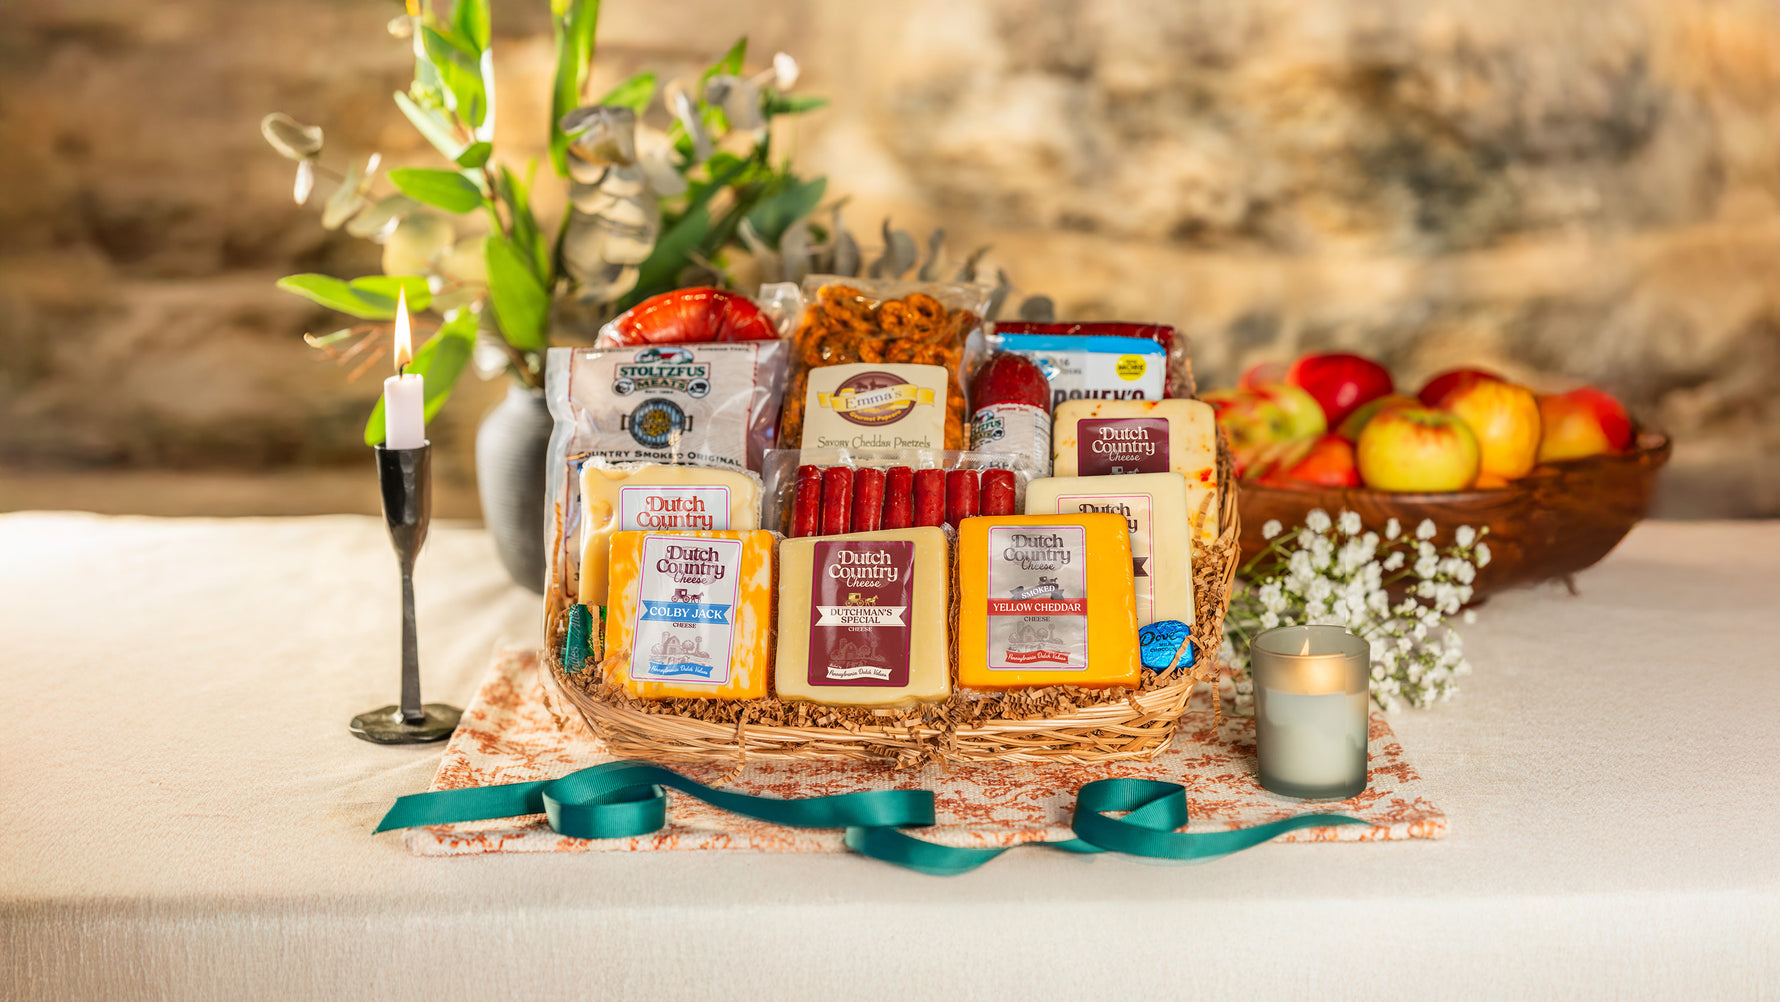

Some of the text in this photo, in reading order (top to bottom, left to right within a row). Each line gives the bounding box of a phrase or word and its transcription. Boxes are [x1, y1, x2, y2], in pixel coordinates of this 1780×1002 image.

[620, 366, 706, 377] STOLTZFUS
[637, 379, 686, 389] MEATS
[845, 388, 903, 409] Emma's
[1099, 427, 1148, 440] Dutch
[817, 434, 931, 449] Savory Cheddar Pretzels
[1092, 440, 1155, 456] Country
[688, 451, 742, 467] ORIGINAL
[1109, 451, 1141, 462] Cheese
[646, 496, 705, 512] Dutch
[1079, 503, 1131, 517] Dutch
[637, 511, 713, 531] Country
[1012, 534, 1064, 548] Dutch
[666, 545, 719, 562] Dutch
[838, 550, 891, 565] Dutch
[1003, 547, 1072, 565] Country
[656, 559, 726, 580] Country
[1021, 557, 1055, 570] Cheese
[674, 572, 708, 584] Cheese
[828, 563, 898, 582] Country
[846, 576, 881, 588] Cheese
[1021, 585, 1055, 600] SMOKED
[649, 606, 723, 620] COLBY JACK
[830, 608, 893, 616] DUTCHMAN'S
[993, 603, 1081, 612] YELLOW CHEDDAR
[841, 616, 881, 624] SPECIAL
[1008, 653, 1036, 662] Pennsylvania
[829, 669, 857, 678] Pennsylvania
